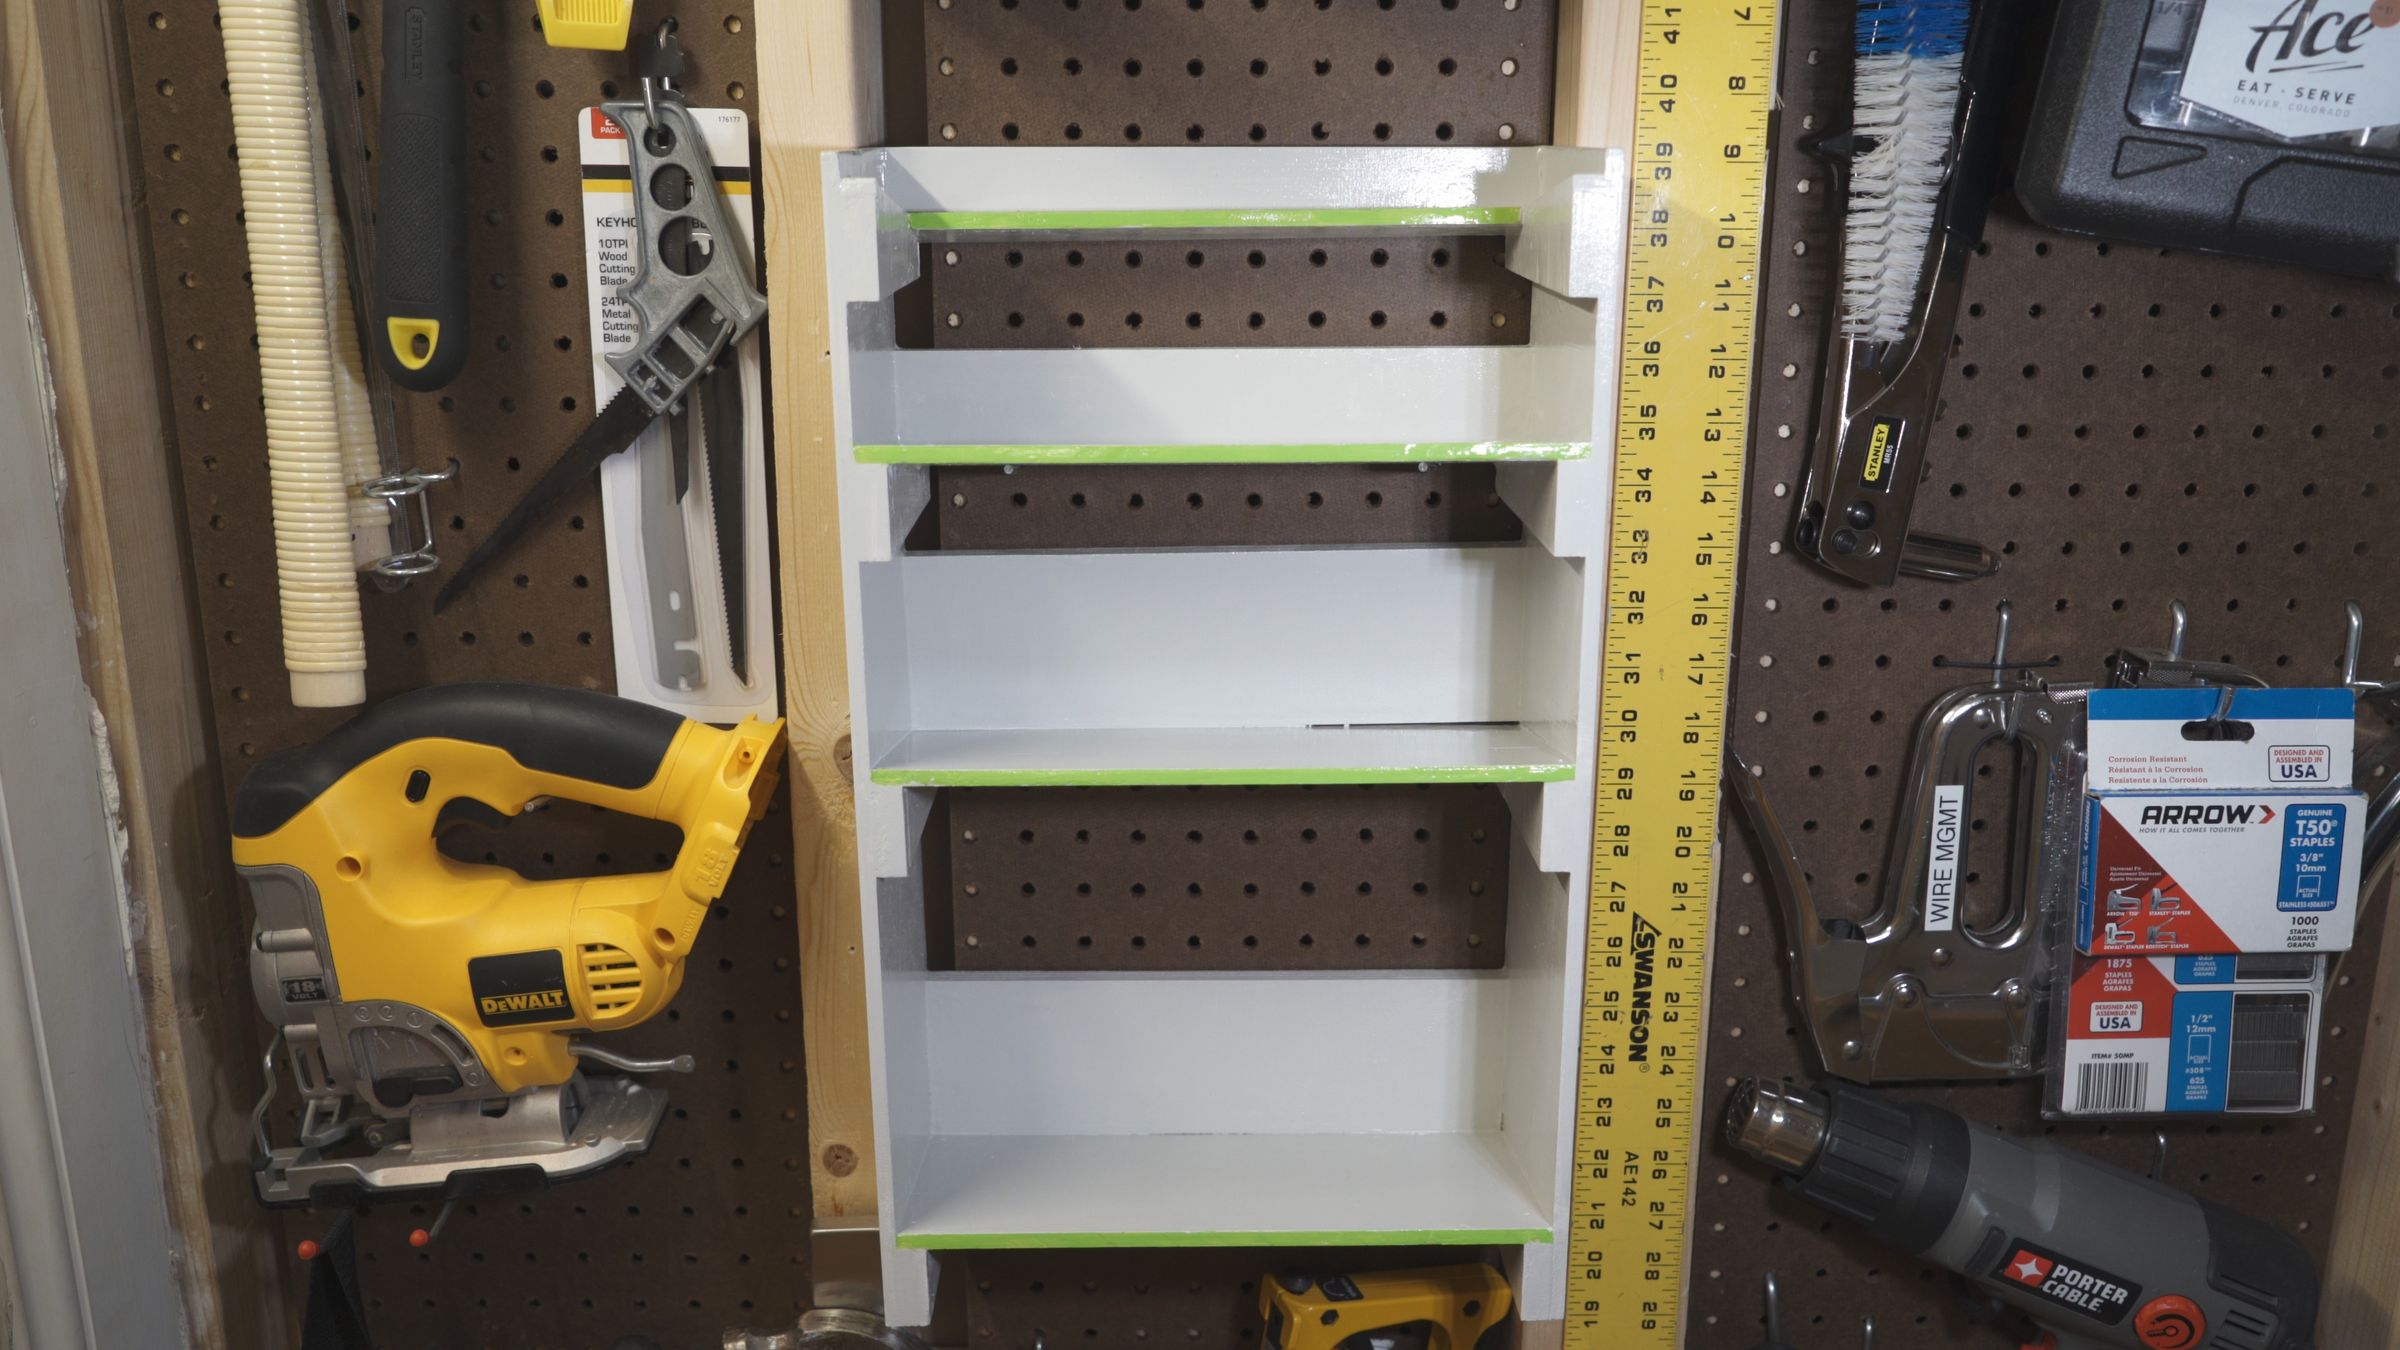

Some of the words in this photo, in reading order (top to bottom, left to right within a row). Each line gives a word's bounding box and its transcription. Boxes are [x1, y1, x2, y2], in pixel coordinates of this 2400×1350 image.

[1663, 7, 1682, 44] 41
[1734, 7, 1751, 21] 7
[2245, 0, 2375, 73] Ace
[1659, 74, 1677, 113] 40
[1728, 76, 1746, 90] 8
[2237, 80, 2272, 94] EAT
[2294, 87, 2357, 105] SERVE
[718, 116, 741, 124] 176177
[2288, 104, 2350, 118] COLORADO
[1654, 142, 1673, 180] 39
[1724, 144, 1741, 158] 9
[597, 217, 638, 228] KEYHO
[1650, 209, 1669, 247] 38
[1717, 213, 1735, 248] 10
[598, 239, 628, 248] 10TPI
[598, 252, 628, 260] Wood
[599, 264, 636, 276] Cutting
[600, 276, 628, 286] Blade
[1646, 276, 1664, 313] 37
[1713, 279, 1731, 312] 11
[602, 309, 631, 318] Metal
[603, 322, 639, 332] Cutting
[603, 334, 631, 342] Blade
[1643, 341, 1661, 377] 36
[1709, 344, 1726, 378] 12
[1638, 404, 1657, 440] 35
[1704, 407, 1722, 442] 13
[1868, 428, 1885, 477] STANLEY
[1635, 467, 1652, 503] 34
[1700, 470, 1717, 504] 14
[1631, 529, 1649, 564] 33
[1696, 532, 1713, 565] 15
[1627, 590, 1645, 624] 32
[1691, 593, 1708, 625] 16
[1623, 653, 1641, 684] 31
[1687, 653, 1704, 685] 17
[1620, 709, 1637, 742] 30
[1683, 712, 1700, 743] 18
[1617, 767, 1633, 800] 29
[1679, 770, 1696, 801] 19
[2281, 764, 2317, 778] USA
[1935, 795, 1958, 861] MGMT
[2141, 804, 2256, 825] ARROW
[1613, 825, 1630, 857] 28
[1675, 826, 1692, 858] 20
[2290, 837, 2336, 847] STAPLES
[2296, 864, 2326, 872] 10mm
[2300, 853, 2324, 862] 3/8"
[1609, 881, 1626, 912] 27
[1671, 882, 1687, 911] 21
[1930, 868, 1952, 922] WIRE
[2291, 916, 2319, 926] 1000
[1606, 936, 1623, 967] 26
[1667, 937, 1683, 968] 22
[2107, 958, 2132, 968] 1875
[291, 980, 315, 993] 18
[292, 992, 318, 1000] VOLT
[1629, 931, 1656, 1062] SWANSON
[1602, 990, 1619, 1021] 25
[1663, 992, 1679, 1022] 23
[2100, 1017, 2131, 1029] USA
[2186, 1025, 2216, 1033] 12mm
[1599, 1044, 1616, 1074] 24
[1659, 1045, 1676, 1075] 24
[1596, 1097, 1612, 1127] 23
[1656, 1098, 1672, 1128] 25
[1593, 1149, 1609, 1178] 22
[1622, 1151, 1639, 1206] AE142
[1652, 1150, 1668, 1179] 26
[1590, 1202, 1605, 1229] 21
[1649, 1201, 1664, 1230] 27
[1587, 1251, 1602, 1279] 20
[1645, 1252, 1660, 1280] 28
[2042, 1280, 2104, 1312] CABLE
[2052, 1264, 2129, 1304] PORTER
[1584, 1300, 1599, 1327] 19
[1642, 1302, 1657, 1329] 29
